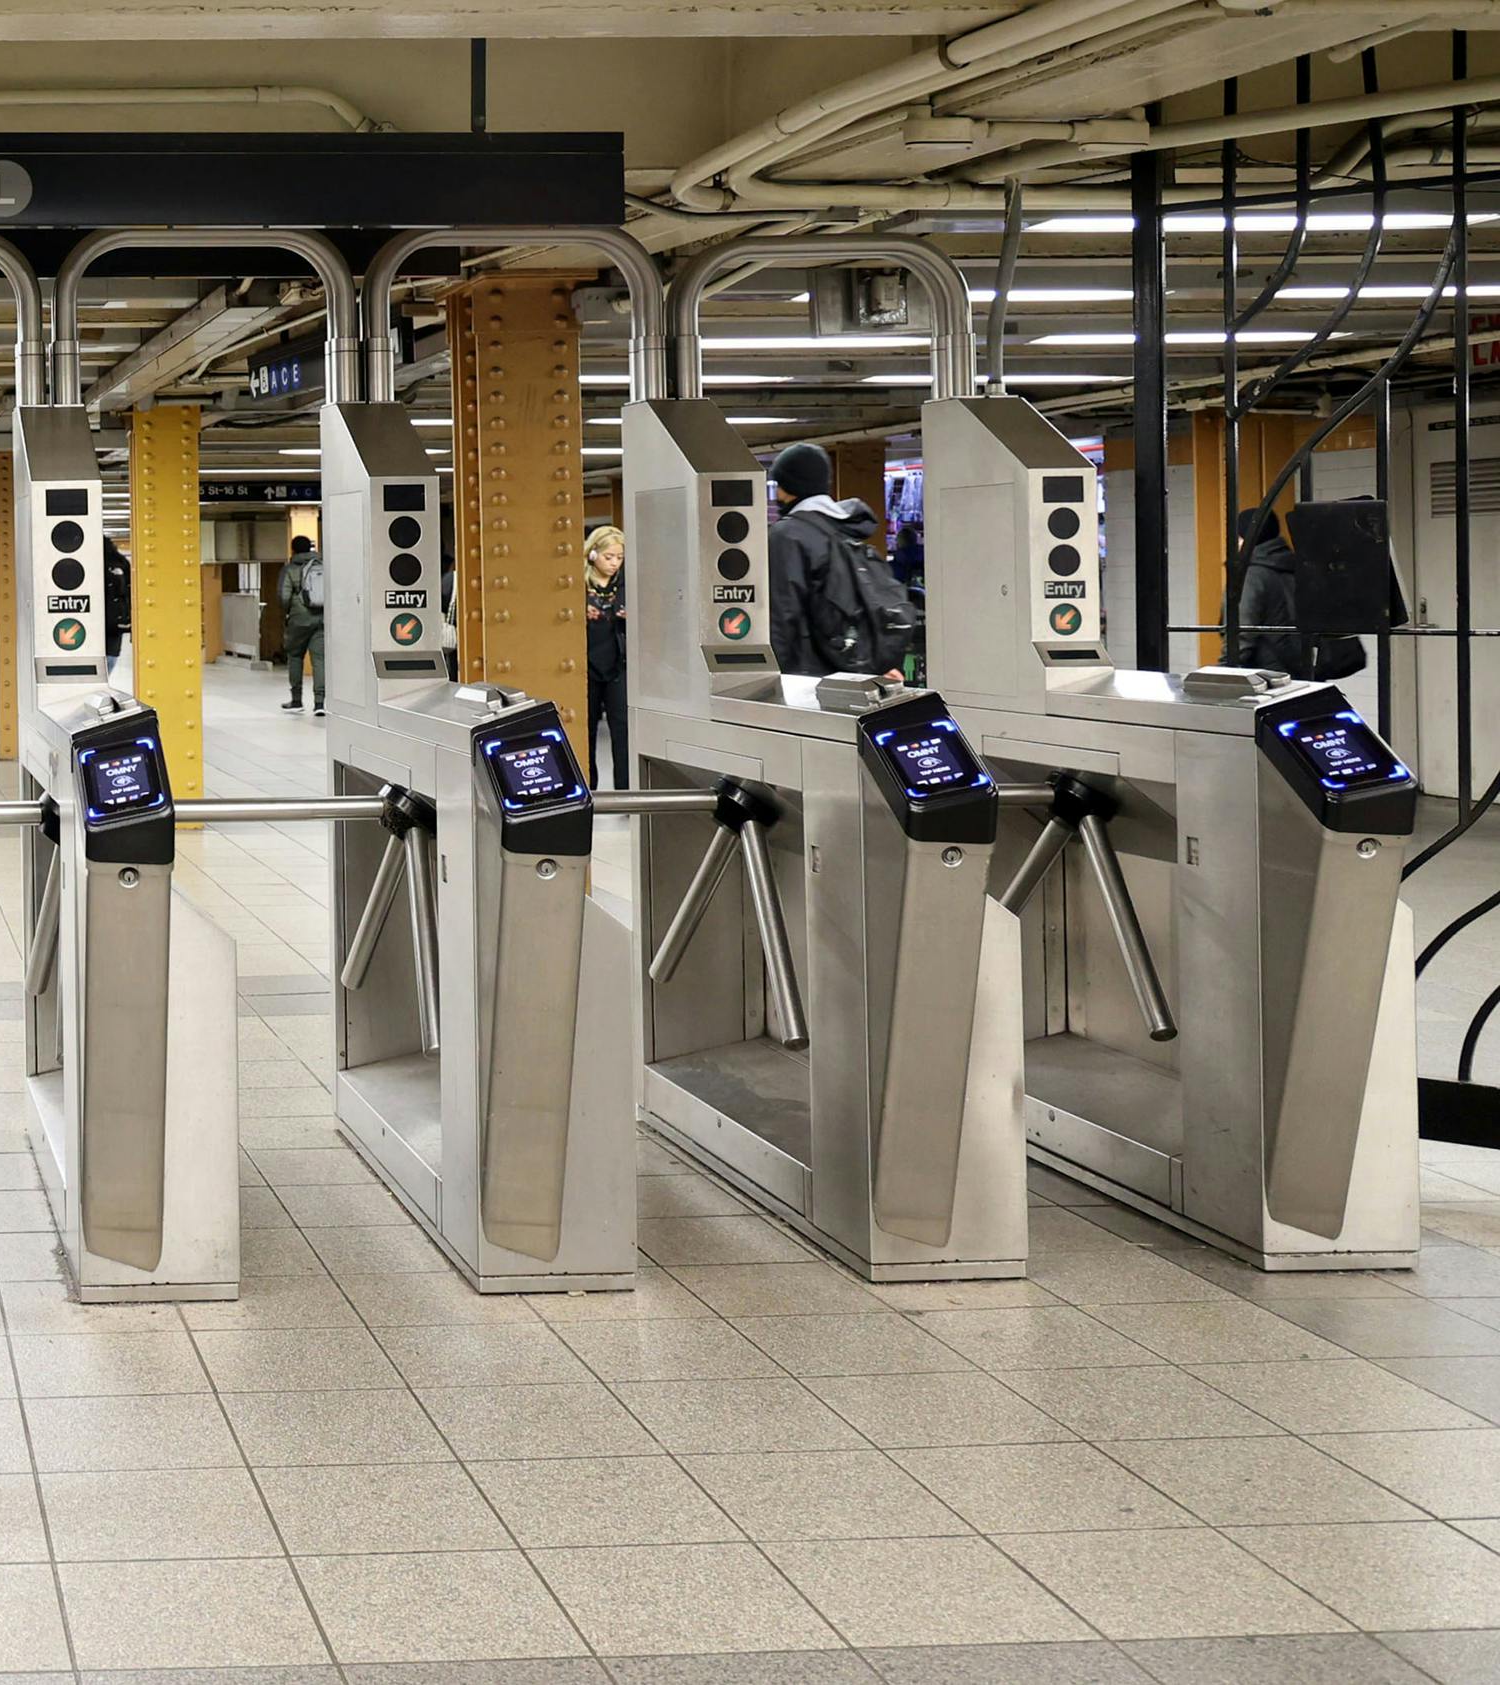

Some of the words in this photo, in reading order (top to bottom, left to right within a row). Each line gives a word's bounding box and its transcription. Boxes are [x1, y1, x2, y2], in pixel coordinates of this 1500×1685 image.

[271, 370, 277, 389] A
[281, 367, 288, 386] C
[292, 363, 299, 383] E
[714, 587, 752, 602] Entry
[1045, 583, 1083, 598] Entry
[48, 596, 88, 612] Entry
[386, 592, 425, 607] Entry
[1313, 737, 1346, 749] OMNY
[907, 745, 939, 758] OMNY
[513, 756, 545, 768] OMNY
[106, 764, 137, 776] OMNY
